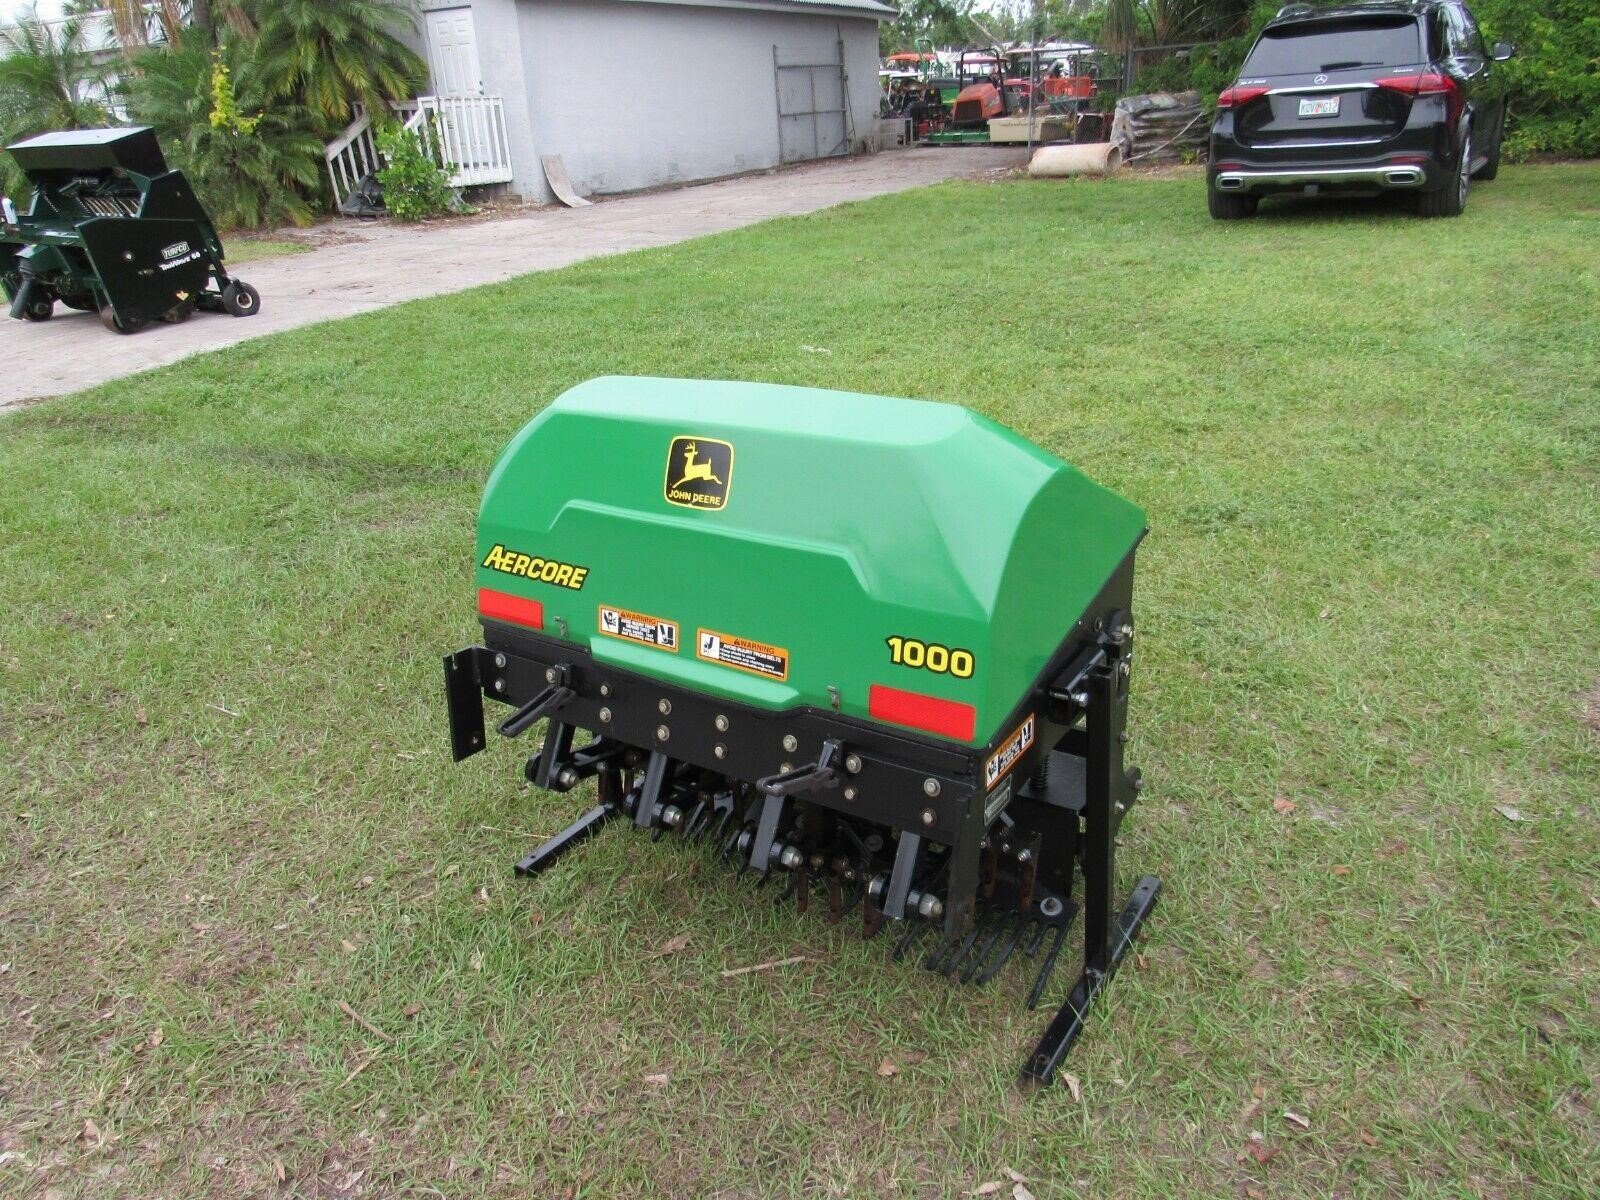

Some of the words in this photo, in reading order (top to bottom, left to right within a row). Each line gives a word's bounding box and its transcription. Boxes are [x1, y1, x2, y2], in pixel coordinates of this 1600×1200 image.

[164, 243, 187, 257] TURFCO
[668, 490, 692, 501] JOHN
[692, 493, 721, 505] DEERE
[481, 544, 589, 590] AERCORE
[625, 612, 656, 625] WARNING
[740, 640, 775, 655] WARNING
[886, 635, 975, 679] 1000
